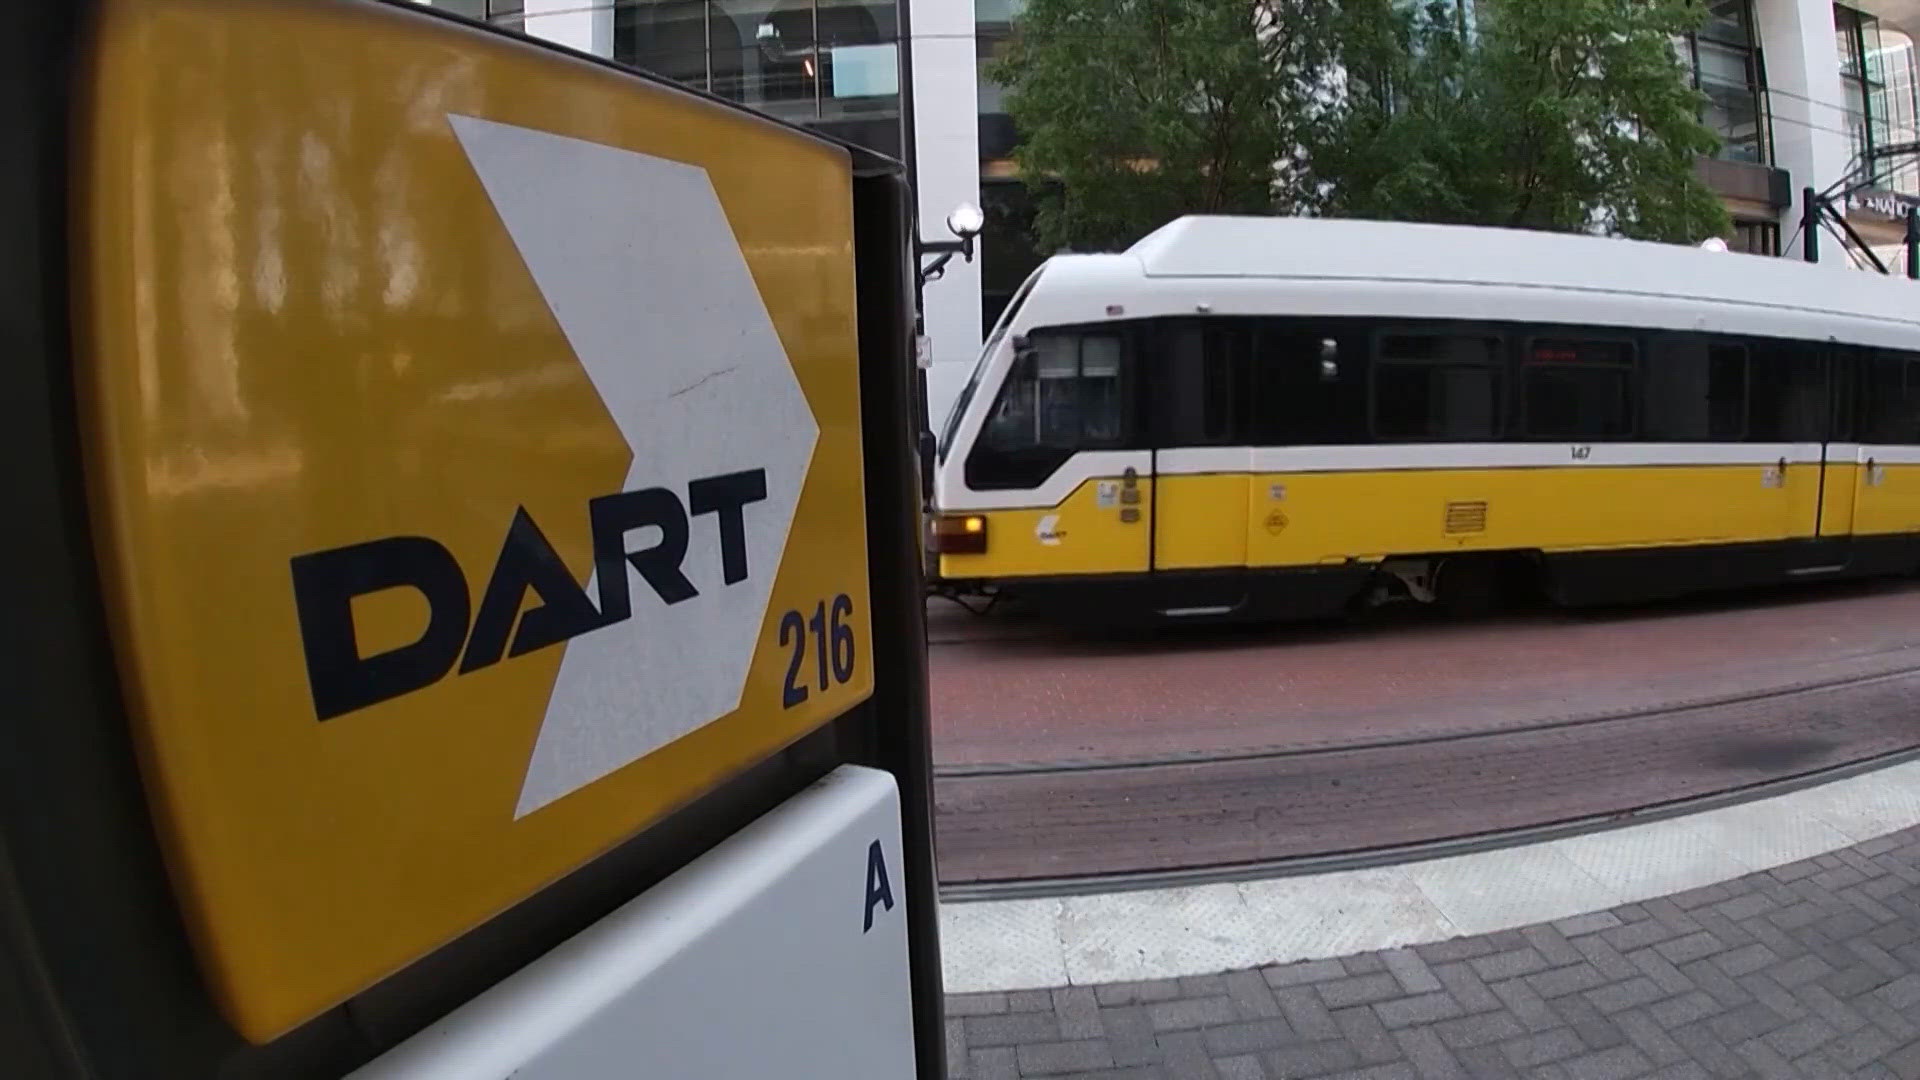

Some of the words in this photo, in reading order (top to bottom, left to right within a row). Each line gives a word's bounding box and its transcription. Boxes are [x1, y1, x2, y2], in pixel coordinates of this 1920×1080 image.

[1571, 446, 1592, 460] 147
[290, 468, 767, 722] DART
[779, 593, 855, 711] 216
[863, 839, 894, 934] A
